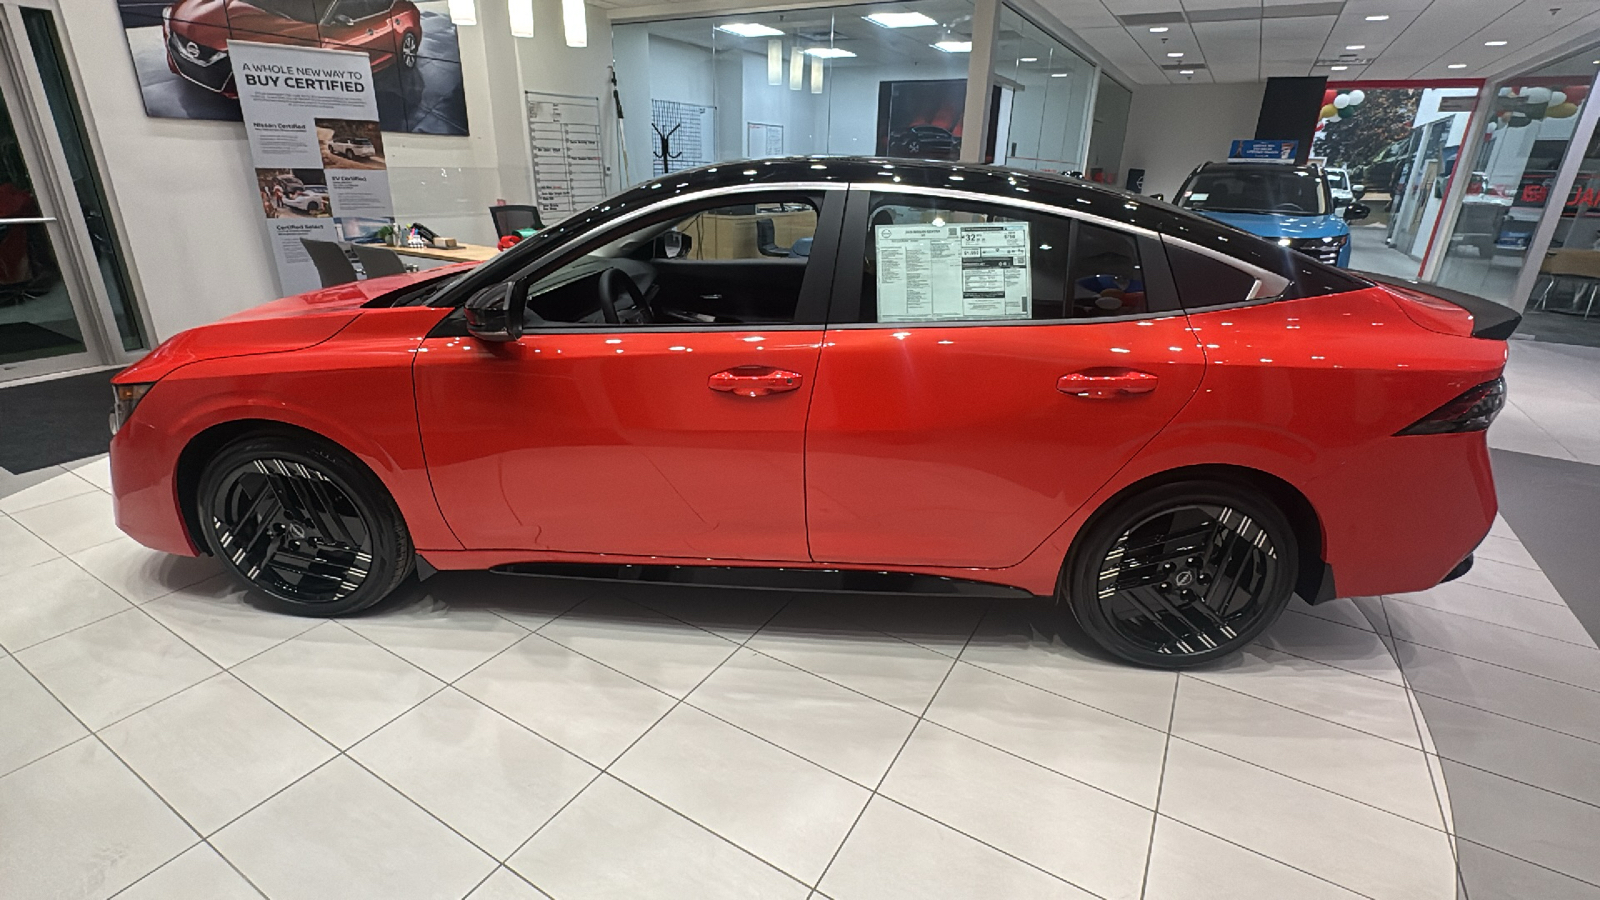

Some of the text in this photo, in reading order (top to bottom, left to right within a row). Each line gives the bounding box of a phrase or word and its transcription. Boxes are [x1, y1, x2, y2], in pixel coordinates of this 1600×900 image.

[242, 63, 362, 80] A WHOLE NEW WAY TO
[245, 74, 365, 93] BUY CERTIFIED
[965, 233, 976, 242] 32
